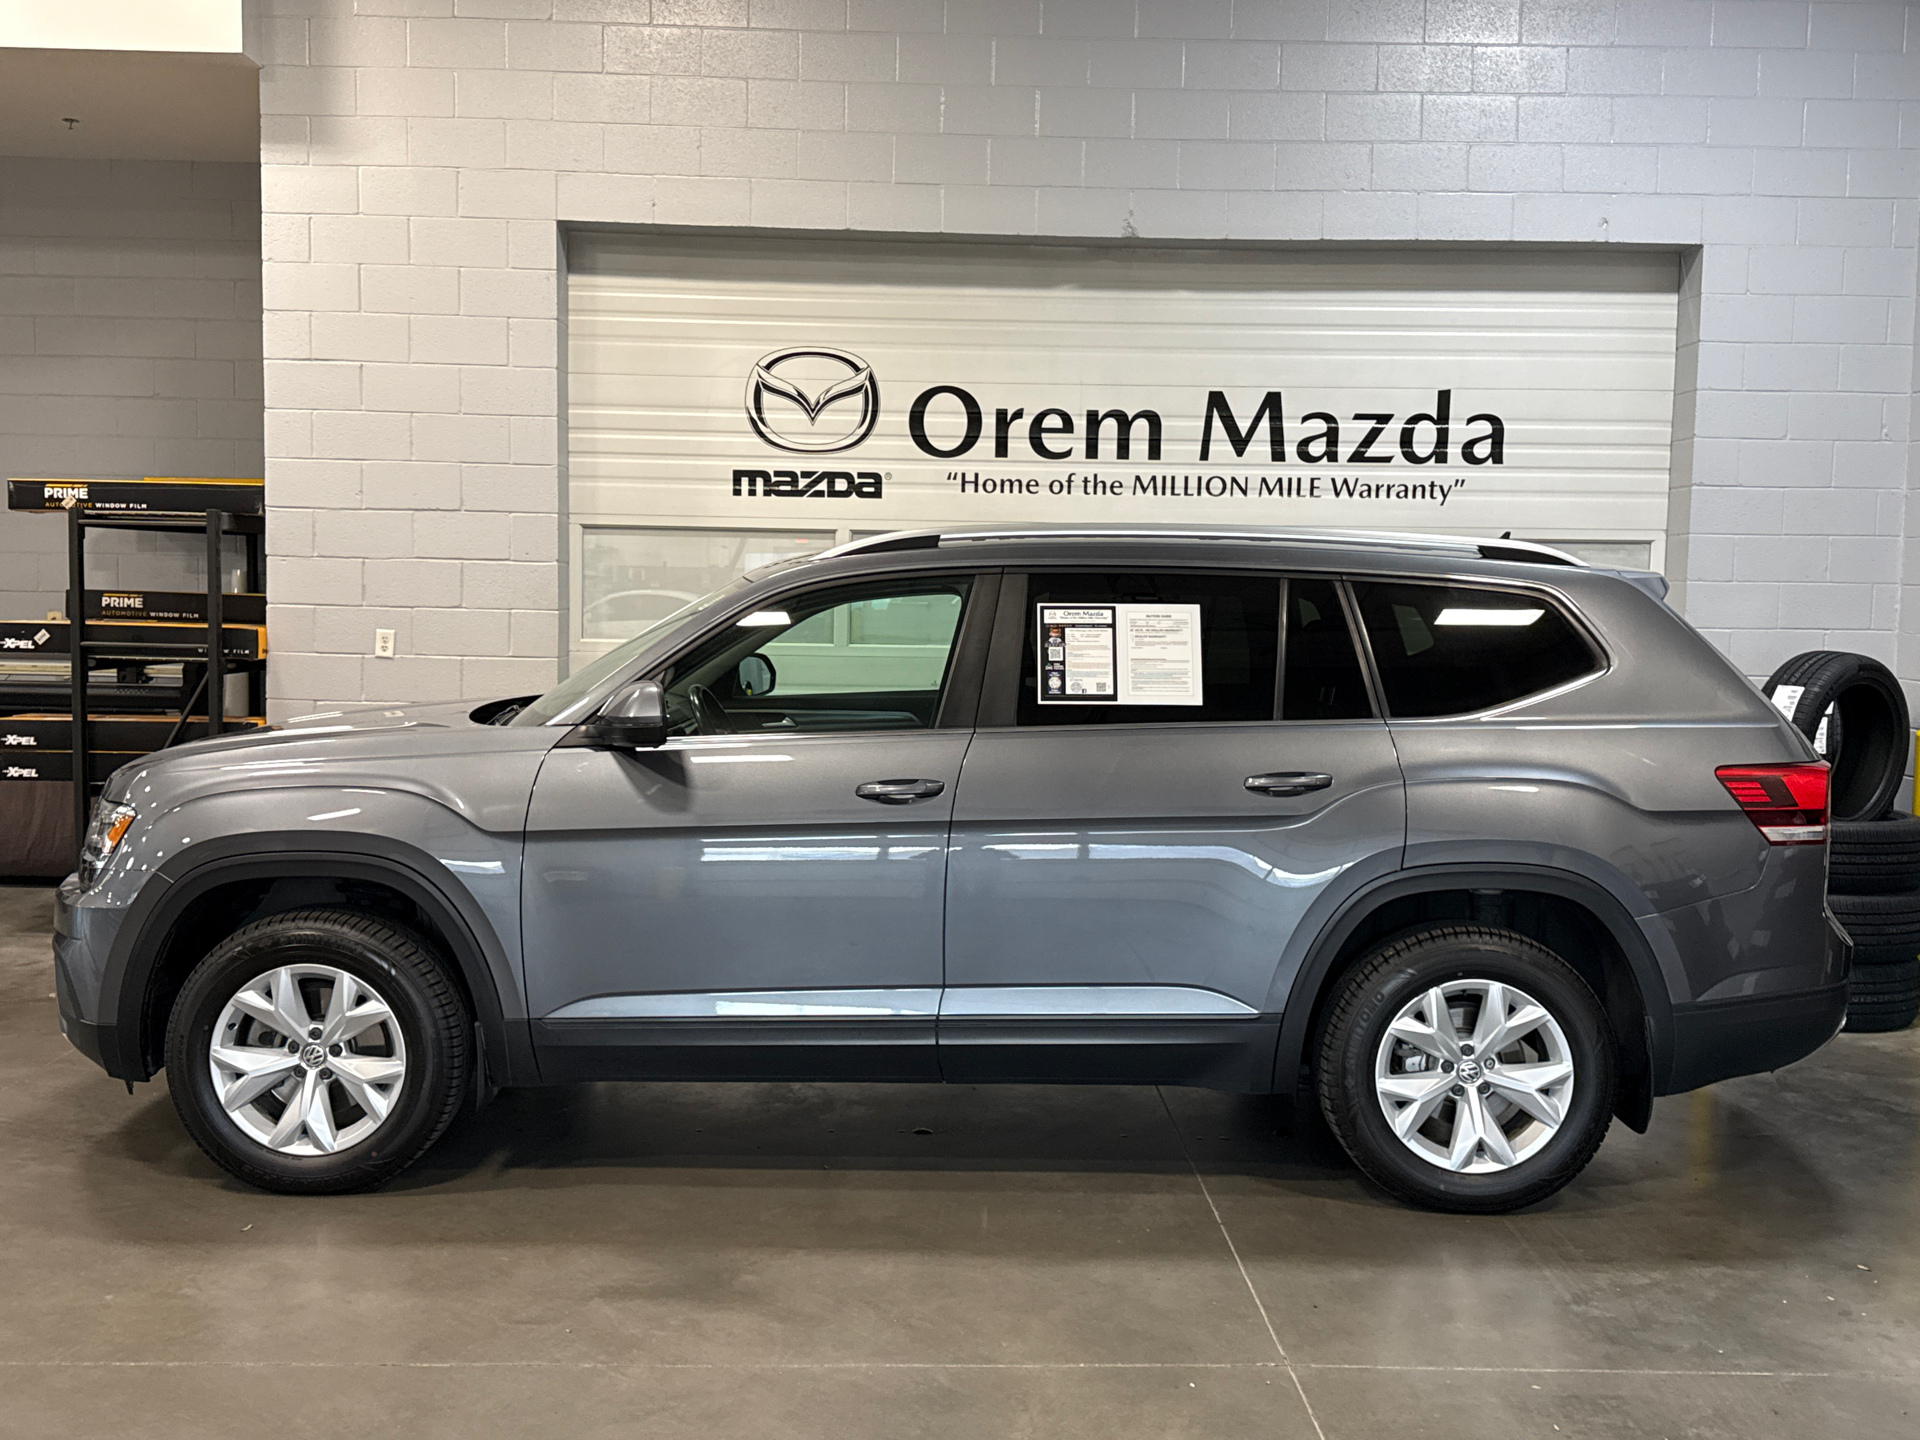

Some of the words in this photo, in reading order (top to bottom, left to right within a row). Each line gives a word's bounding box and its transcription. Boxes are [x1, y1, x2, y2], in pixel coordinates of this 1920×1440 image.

[908, 385, 1162, 461] Orem
[1199, 388, 1505, 466] Mazda
[44, 487, 89, 500] PRIME
[946, 471, 1040, 495] “Home
[1048, 472, 1076, 495] of
[1081, 473, 1124, 496] the
[1132, 475, 1249, 497] MILLION
[1258, 476, 1322, 498] MILE
[1330, 477, 1467, 506] Warranty”
[101, 596, 144, 609] PRIME
[2, 637, 36, 650] XPEL
[4, 734, 38, 746] XPEL
[6, 766, 39, 778] XPEL
